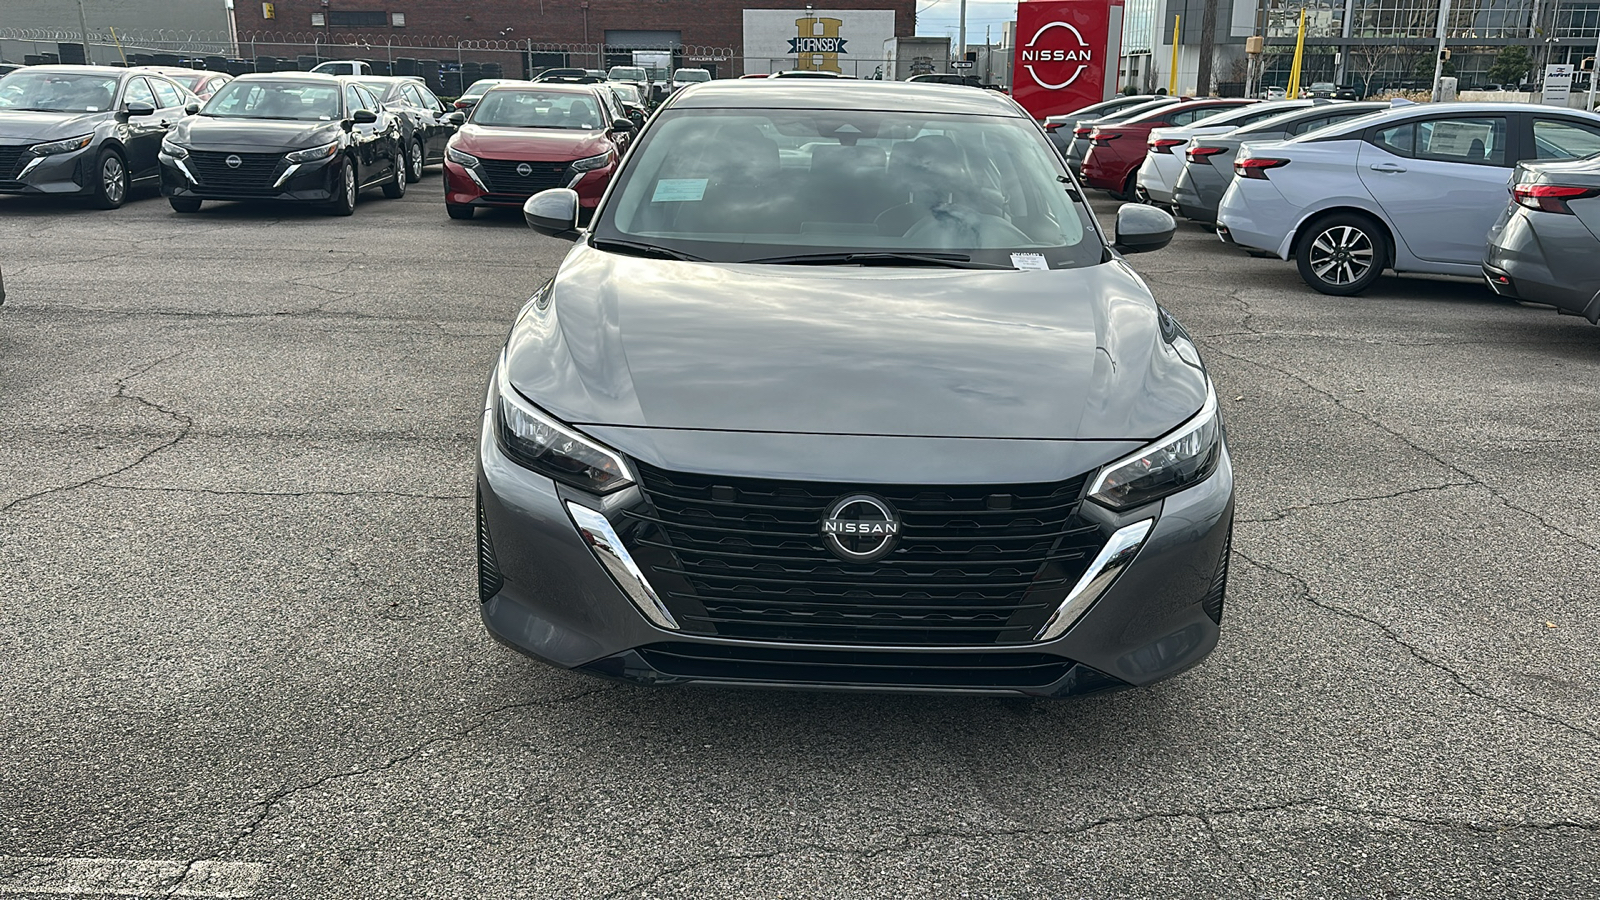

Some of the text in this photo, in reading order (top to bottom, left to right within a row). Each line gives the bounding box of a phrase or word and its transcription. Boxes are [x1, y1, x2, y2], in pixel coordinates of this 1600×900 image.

[796, 38, 841, 52] HORNSBY
[1022, 49, 1092, 61] NISSAN
[825, 521, 897, 533] NISSAN
